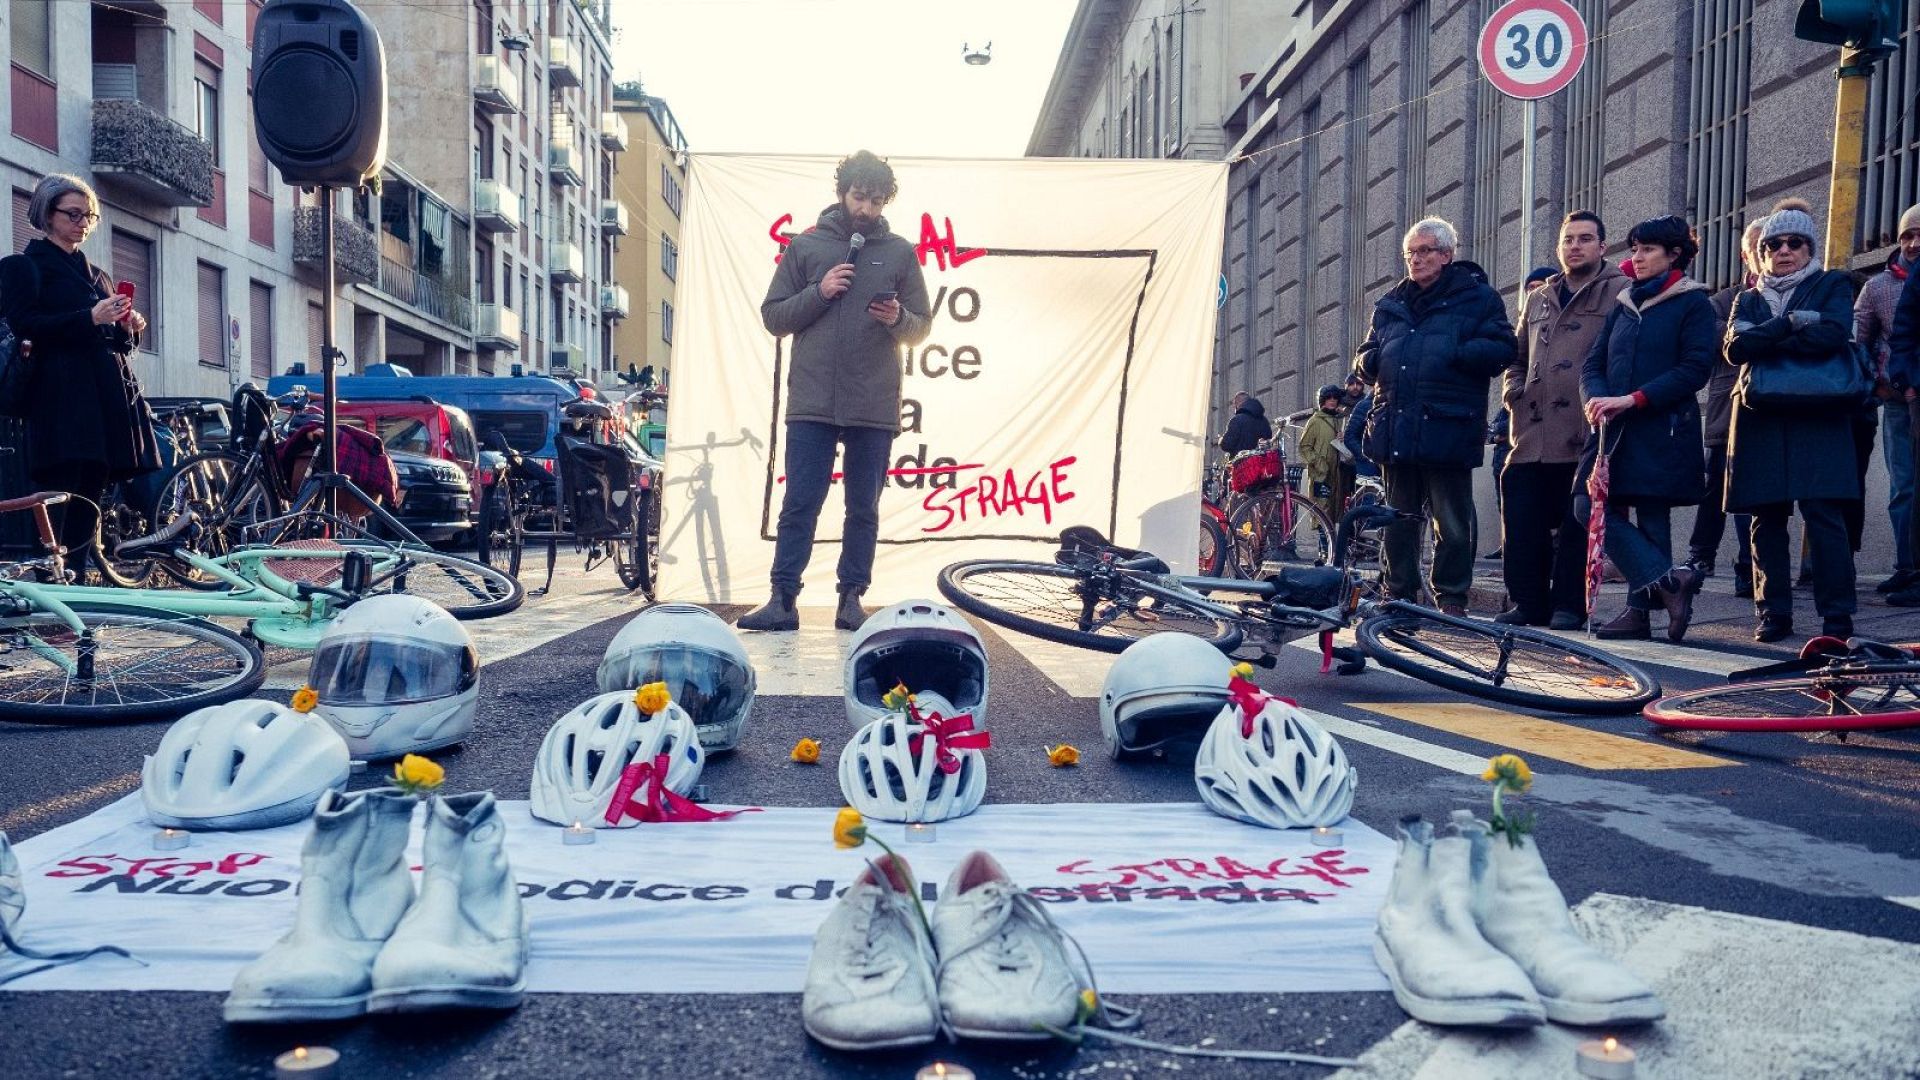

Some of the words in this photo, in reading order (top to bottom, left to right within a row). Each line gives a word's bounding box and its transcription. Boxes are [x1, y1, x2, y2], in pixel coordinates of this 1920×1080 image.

[1505, 22, 1563, 69] 30
[915, 212, 988, 271] AL
[905, 343, 982, 380] ice
[921, 456, 1078, 533] STRAGE
[45, 853, 273, 878] STOP
[1056, 850, 1370, 888] STRAGE
[71, 874, 301, 897] Nuo
[516, 880, 750, 901] odice
[1027, 882, 1320, 904] strada
